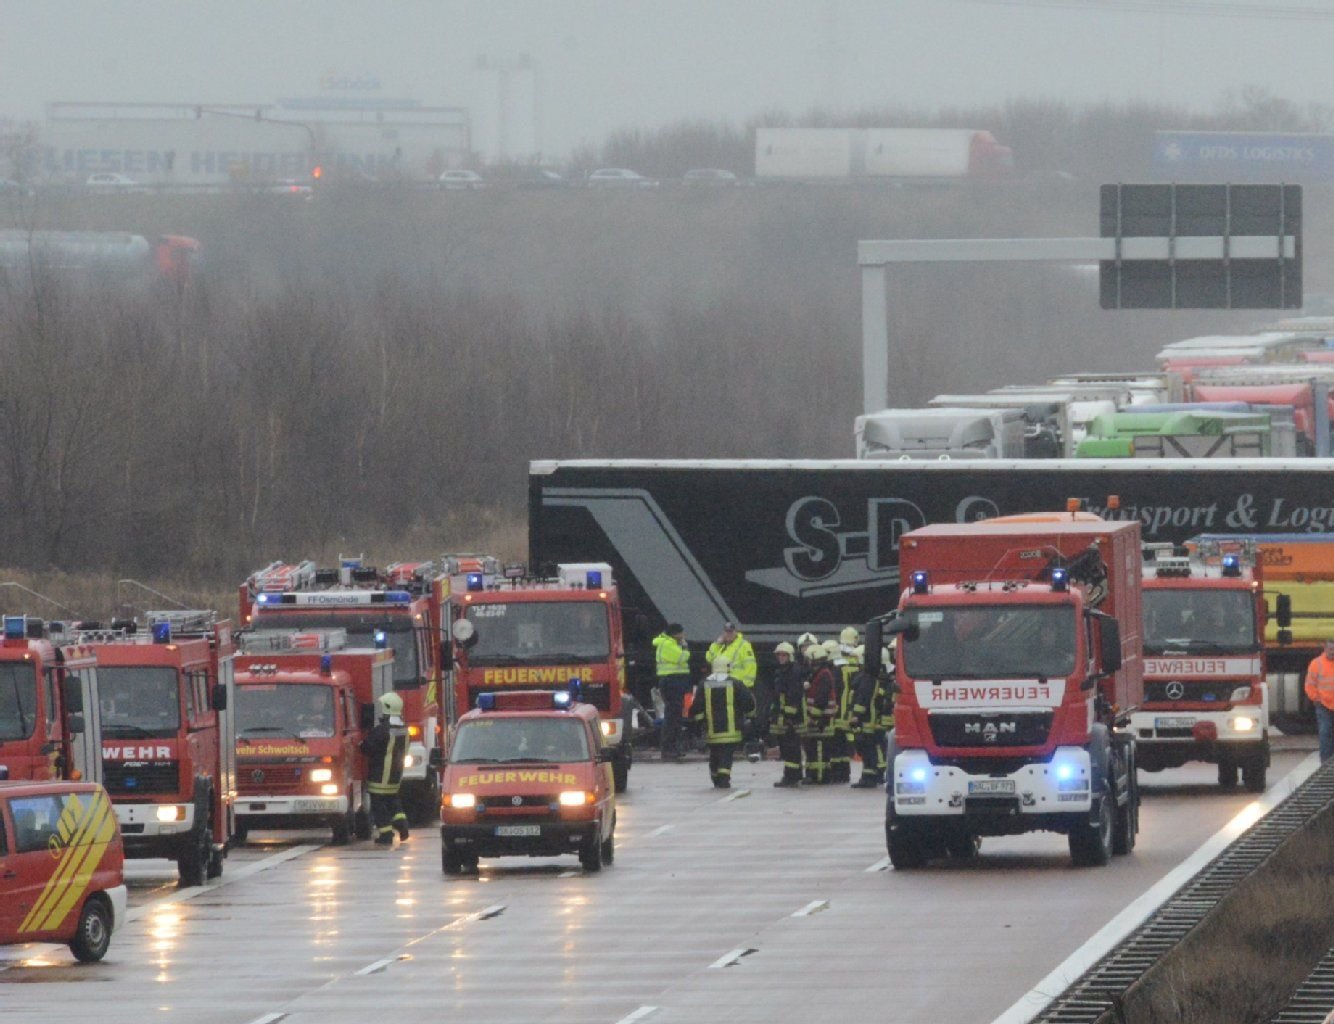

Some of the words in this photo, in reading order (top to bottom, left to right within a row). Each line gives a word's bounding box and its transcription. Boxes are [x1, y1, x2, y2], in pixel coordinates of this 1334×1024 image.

[1225, 493, 1257, 528] &
[484, 666, 593, 684] FEUERWEHR
[964, 721, 1016, 733] MAN
[102, 746, 171, 759] WEHR
[458, 772, 578, 787] FEUERWEHR
